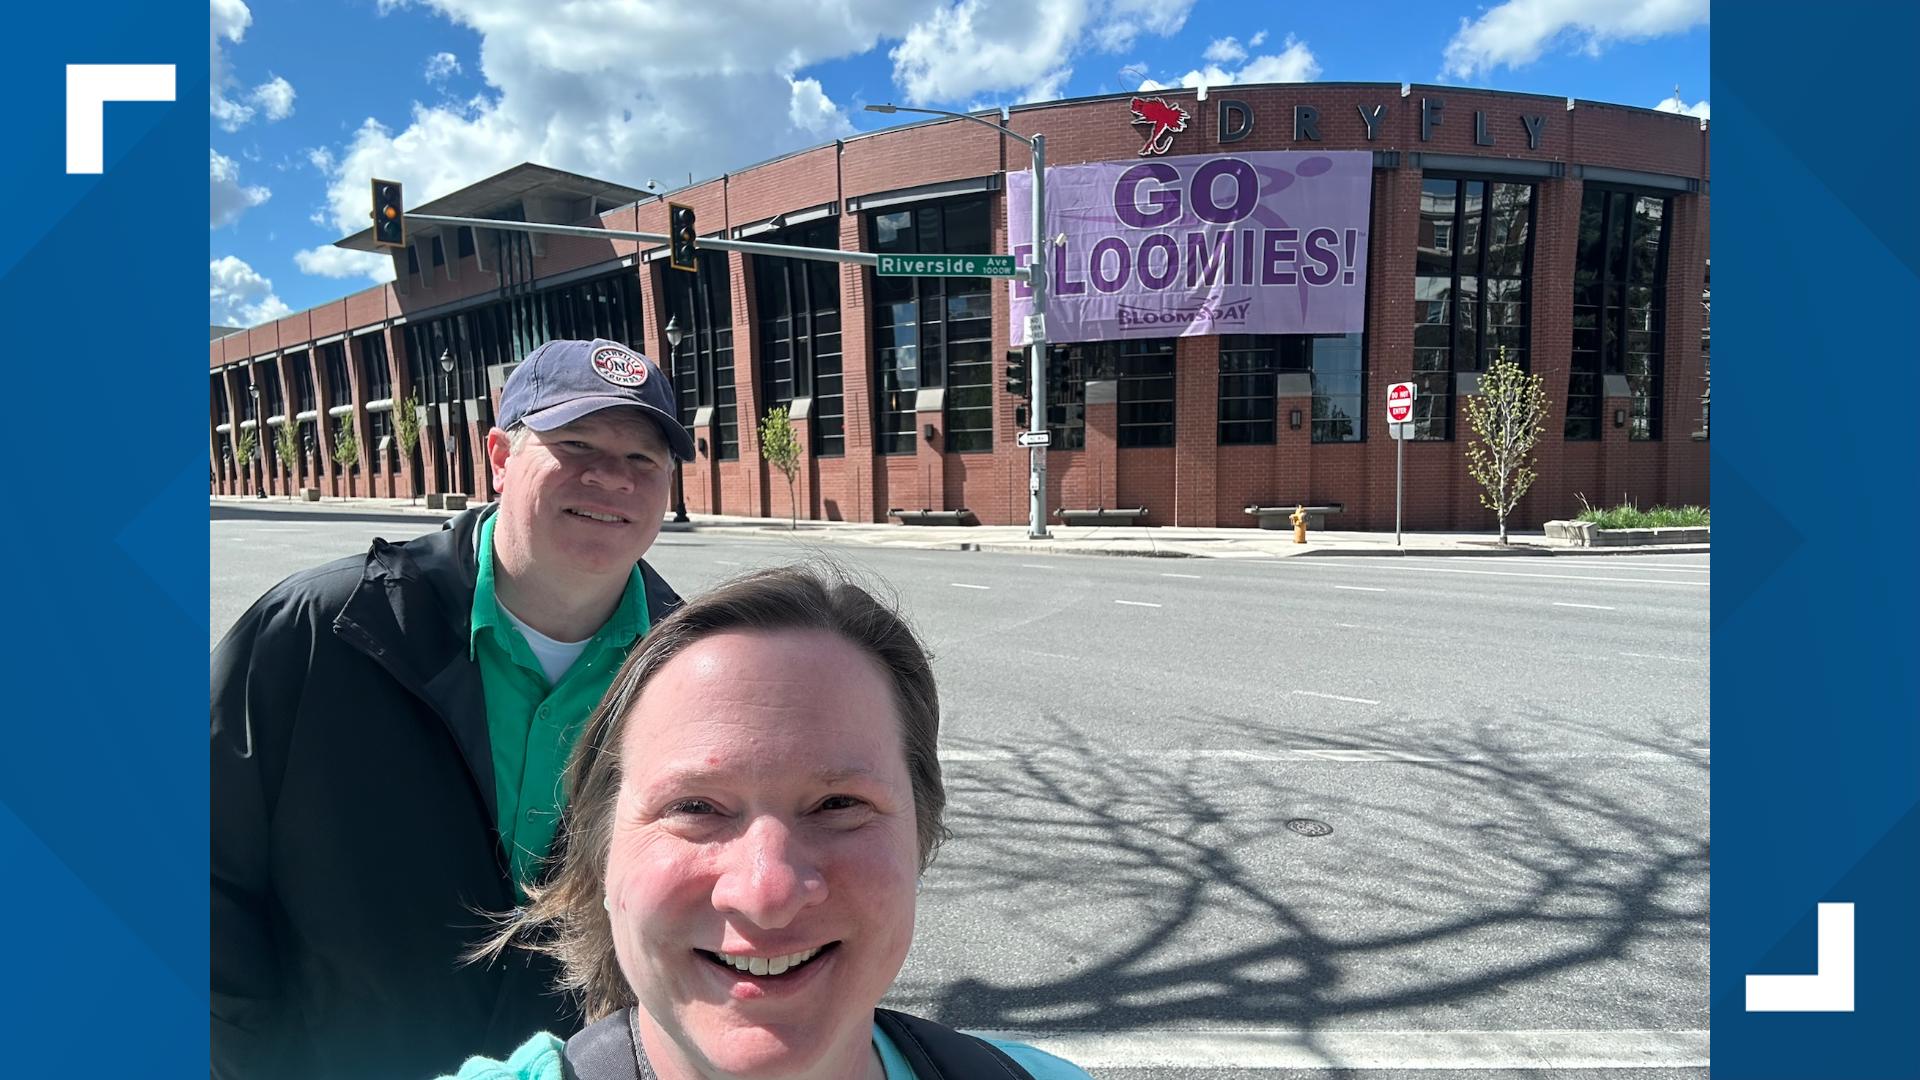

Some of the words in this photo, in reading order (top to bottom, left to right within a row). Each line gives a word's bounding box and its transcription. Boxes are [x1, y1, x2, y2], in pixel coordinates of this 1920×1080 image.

[1113, 157, 1260, 229] GO
[882, 258, 975, 272] Riverside
[987, 257, 1008, 266] Ave
[1118, 303, 1250, 325] BLOOMSDAY
[613, 360, 627, 373] N
